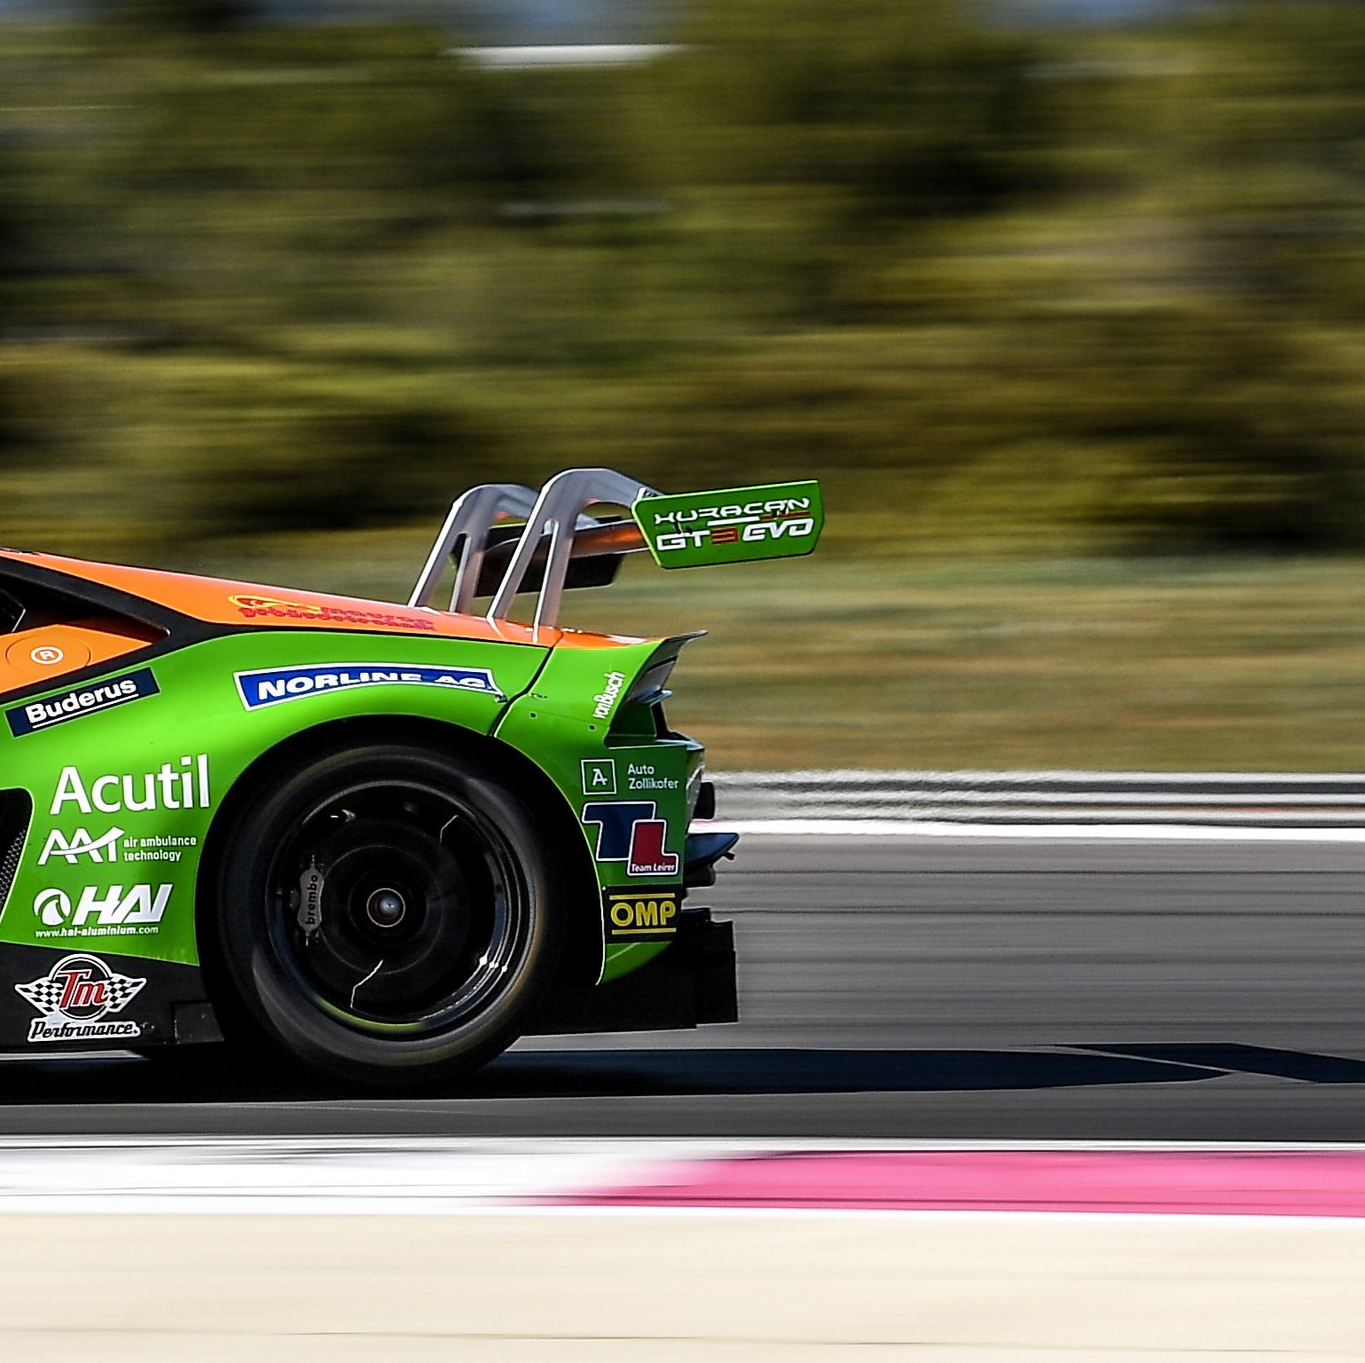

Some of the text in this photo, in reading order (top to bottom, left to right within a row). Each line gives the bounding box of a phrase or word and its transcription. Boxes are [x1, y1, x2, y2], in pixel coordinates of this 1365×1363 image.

[656, 518, 814, 551] GT3 EVO
[258, 671, 486, 701] NORLINE AG
[25, 679, 137, 724] Buderus
[627, 763, 654, 775] Auto
[50, 753, 210, 815] Acutil
[628, 776, 679, 790] Zollikofer
[124, 835, 197, 848] air ambulance
[124, 849, 181, 862] technology
[631, 863, 652, 872] Team
[305, 875, 319, 925] brembo
[610, 900, 677, 927] OMP
[35, 926, 159, 938] www.hai-aluminium.com
